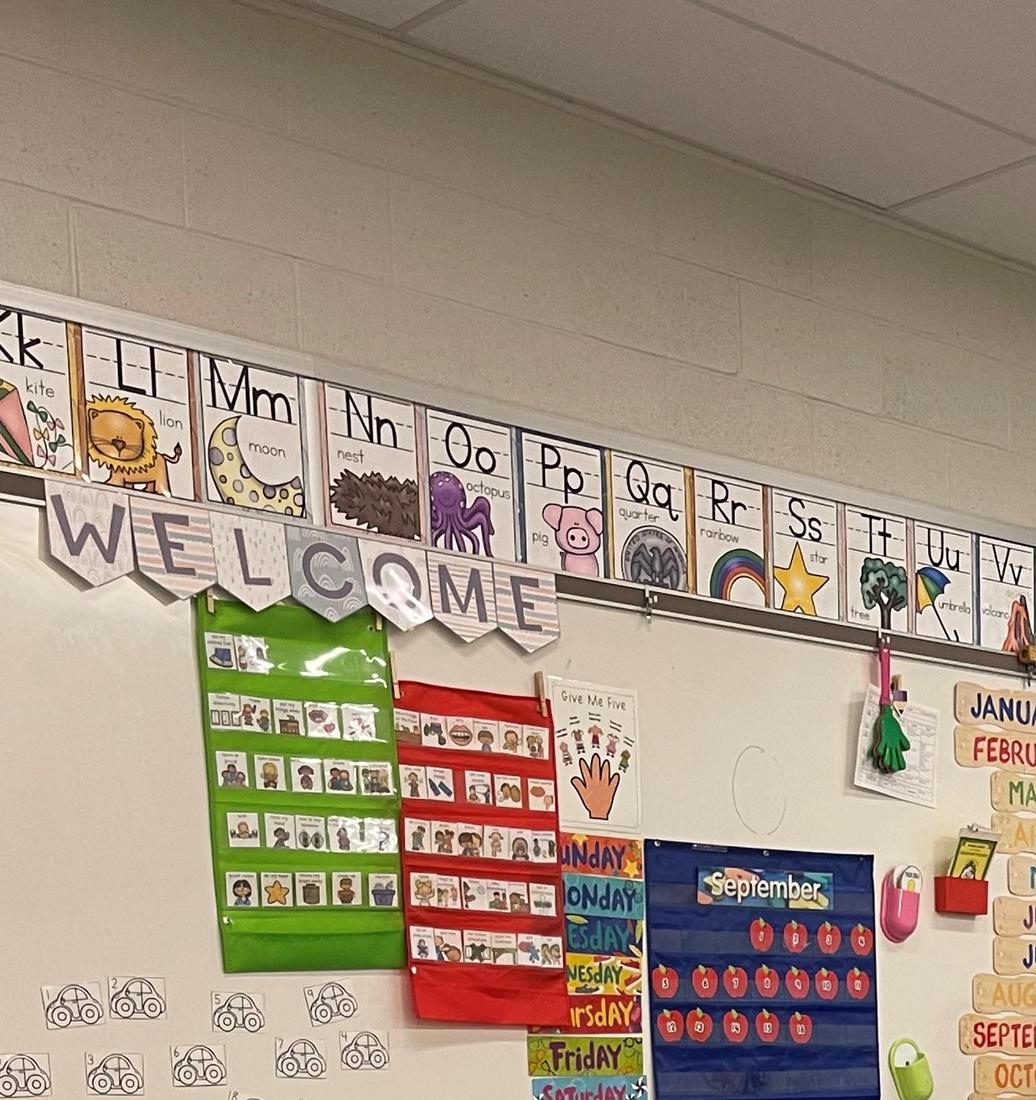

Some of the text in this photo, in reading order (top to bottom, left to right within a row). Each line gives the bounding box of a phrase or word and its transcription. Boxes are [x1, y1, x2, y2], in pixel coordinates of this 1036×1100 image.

[25, 377, 55, 398] kite
[209, 357, 292, 424] Mm
[159, 410, 183, 430] lion
[344, 390, 398, 448] Nn
[248, 441, 286, 458] moon
[337, 447, 365, 464] nest
[445, 422, 496, 474] Oo
[541, 444, 584, 504] Pp
[466, 481, 511, 500] octopus
[626, 460, 679, 521] Qq
[711, 479, 747, 525] Rr
[619, 507, 659, 523] quarter
[788, 497, 822, 542] Ss
[532, 530, 549, 546] pig
[700, 528, 739, 543] rainbow
[860, 513, 892, 557] Tt
[810, 551, 828, 565] star
[927, 528, 960, 571] Uu
[51, 494, 544, 633] WELCOME
[992, 544, 1023, 586] Vv
[850, 607, 870, 621] tree
[938, 600, 971, 615] umbrella
[982, 606, 1009, 619] volcano
[561, 690, 627, 711] Give Me Five
[710, 871, 821, 903] September
[111, 978, 118, 989] 2
[214, 994, 221, 1005] 5
[307, 989, 314, 999] 9
[277, 1039, 284, 1049] 7
[341, 1031, 347, 1041] 4
[88, 1054, 94, 1065] 3
[173, 1047, 180, 1058] 6
[231, 1091, 238, 1100] 8
